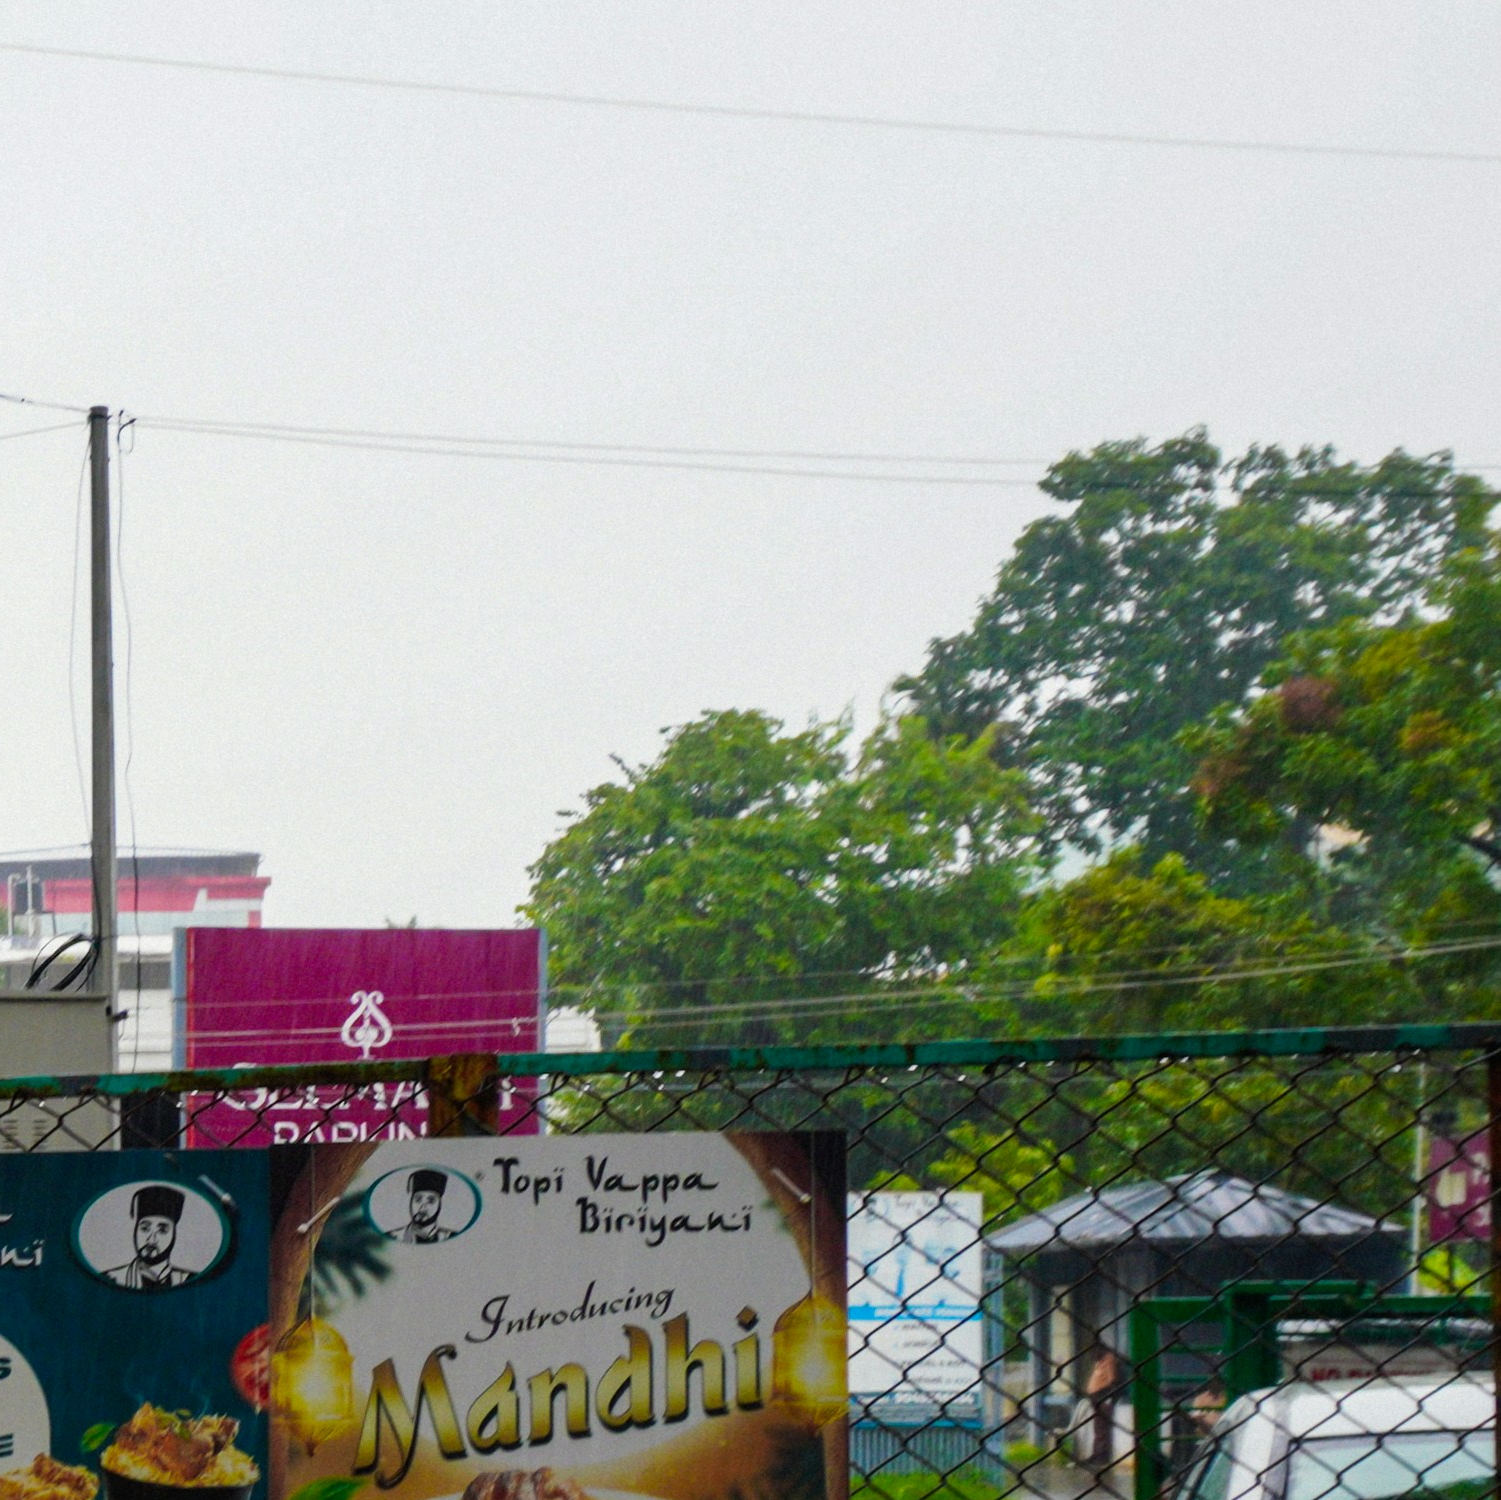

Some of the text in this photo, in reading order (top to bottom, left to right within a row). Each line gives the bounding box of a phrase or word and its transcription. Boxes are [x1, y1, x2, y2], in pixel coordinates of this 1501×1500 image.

[586, 1155, 719, 1203] Vappa
[464, 1279, 678, 1344] Introducing
[351, 1305, 766, 1491] Mandhi
